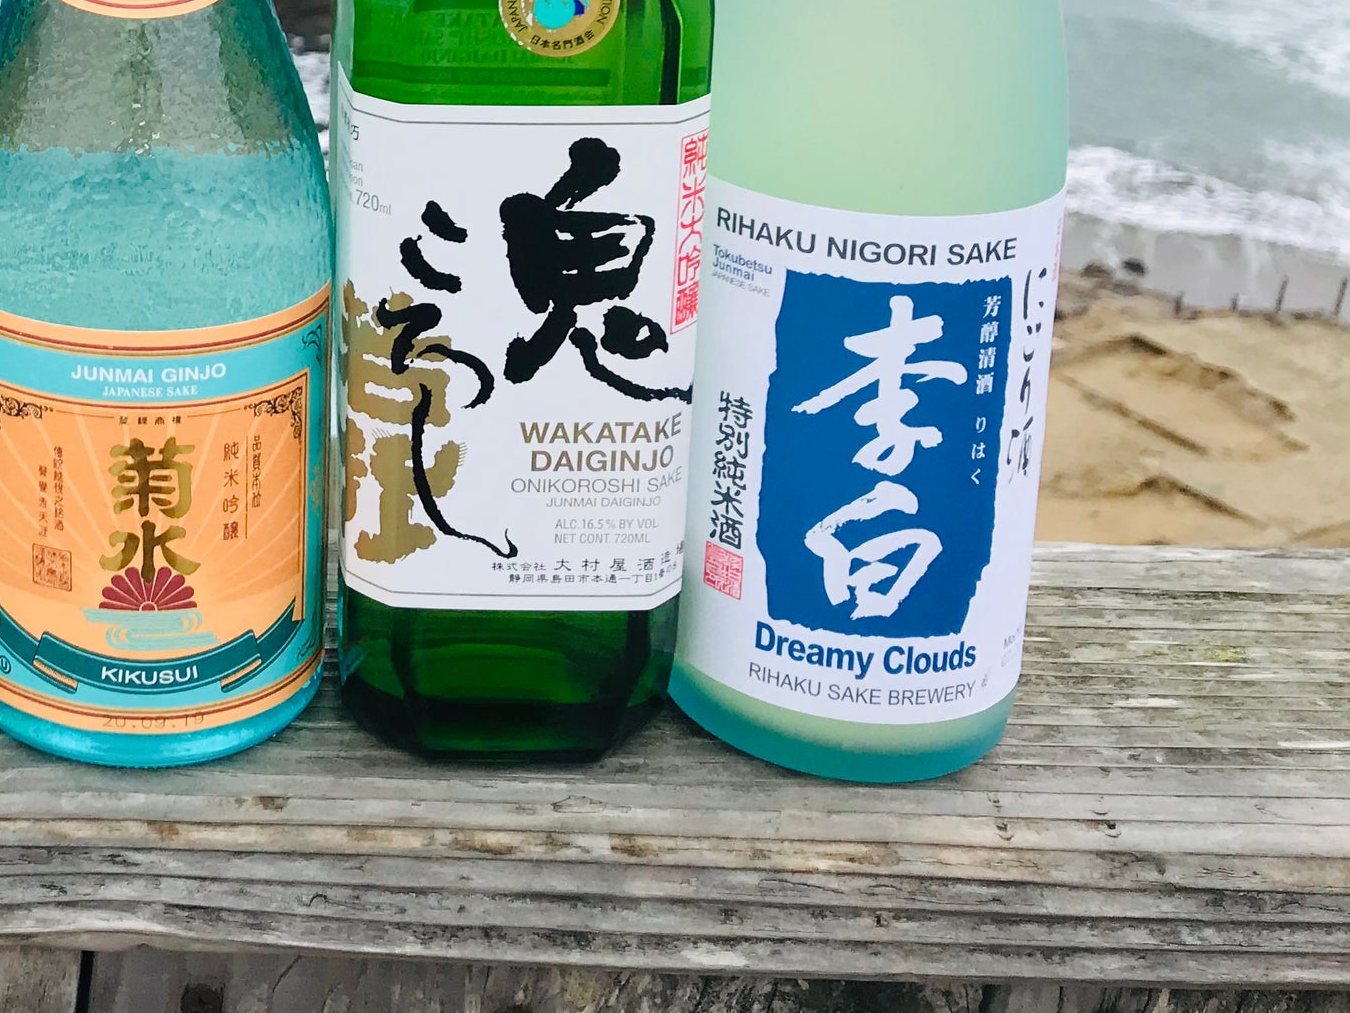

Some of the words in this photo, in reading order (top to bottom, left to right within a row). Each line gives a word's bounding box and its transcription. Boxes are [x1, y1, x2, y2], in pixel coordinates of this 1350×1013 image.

[507, 0, 528, 32] JAPAN
[717, 206, 816, 254] RIHAKU
[827, 236, 936, 266] NIGORI
[946, 237, 1018, 266] SAKE
[499, 137, 693, 404] 鬼
[712, 258, 755, 281] Junmai
[713, 244, 773, 275] Tokubetsu
[975, 295, 1002, 395] 芳醇清酒
[71, 364, 153, 383] JUNMAI
[161, 363, 227, 383] GINJO
[102, 386, 163, 398] JAPANESE
[166, 385, 199, 397] SAKE
[519, 412, 682, 444] WAKATAKE
[531, 445, 674, 472] DAIGINJO
[791, 295, 968, 620] 李白
[970, 416, 987, 485] りはく
[511, 478, 640, 493] ONIKOROSHI
[647, 465, 683, 493] SAKE
[709, 390, 753, 550] 特別純米酒
[99, 436, 201, 584] 菊水
[546, 497, 597, 508] JUNMAI
[601, 495, 661, 508] DAIGINJO
[554, 533, 576, 544] NET
[577, 533, 612, 544] CONT.
[615, 533, 651, 544] 720ML
[619, 519, 634, 529] BY
[755, 620, 874, 680] Dreamy
[883, 641, 977, 675] Clouds
[101, 665, 199, 685] KIKUSUI
[749, 662, 821, 697] RIHAKU
[827, 683, 881, 705] SAKE
[888, 679, 977, 706] BREWERY
